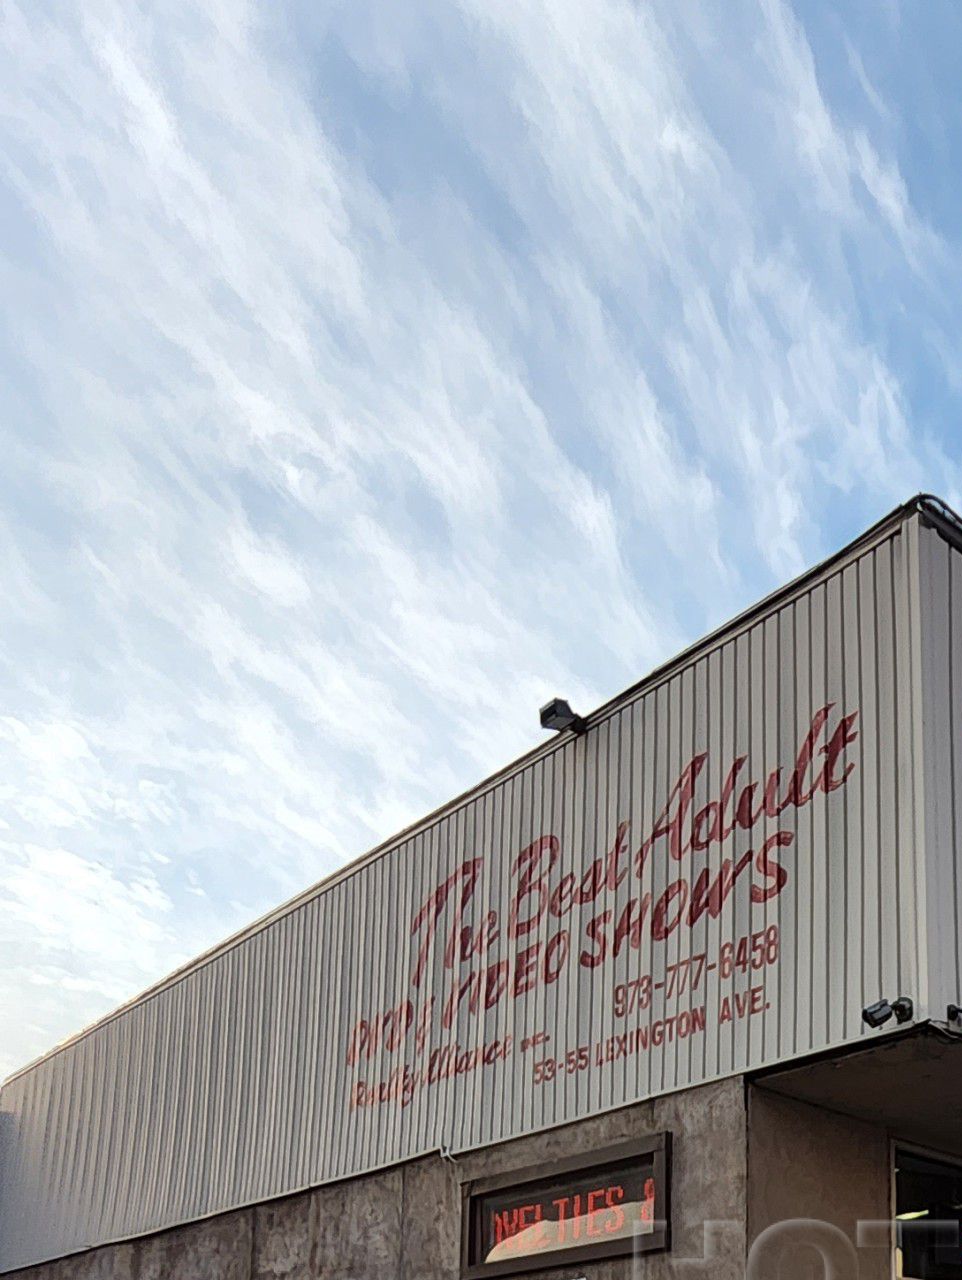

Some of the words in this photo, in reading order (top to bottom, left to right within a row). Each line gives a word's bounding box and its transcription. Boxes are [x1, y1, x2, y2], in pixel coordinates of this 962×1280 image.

[411, 856, 500, 989] The
[507, 820, 631, 941] Best
[635, 701, 859, 879] Adult
[442, 930, 571, 1031] VIDEO
[579, 831, 795, 968] SHOWS
[615, 924, 779, 1018] 973-777-6458
[533, 1047, 590, 1084] 53-55
[595, 1006, 706, 1067] LEXINGTON
[719, 984, 771, 1025] AVE.
